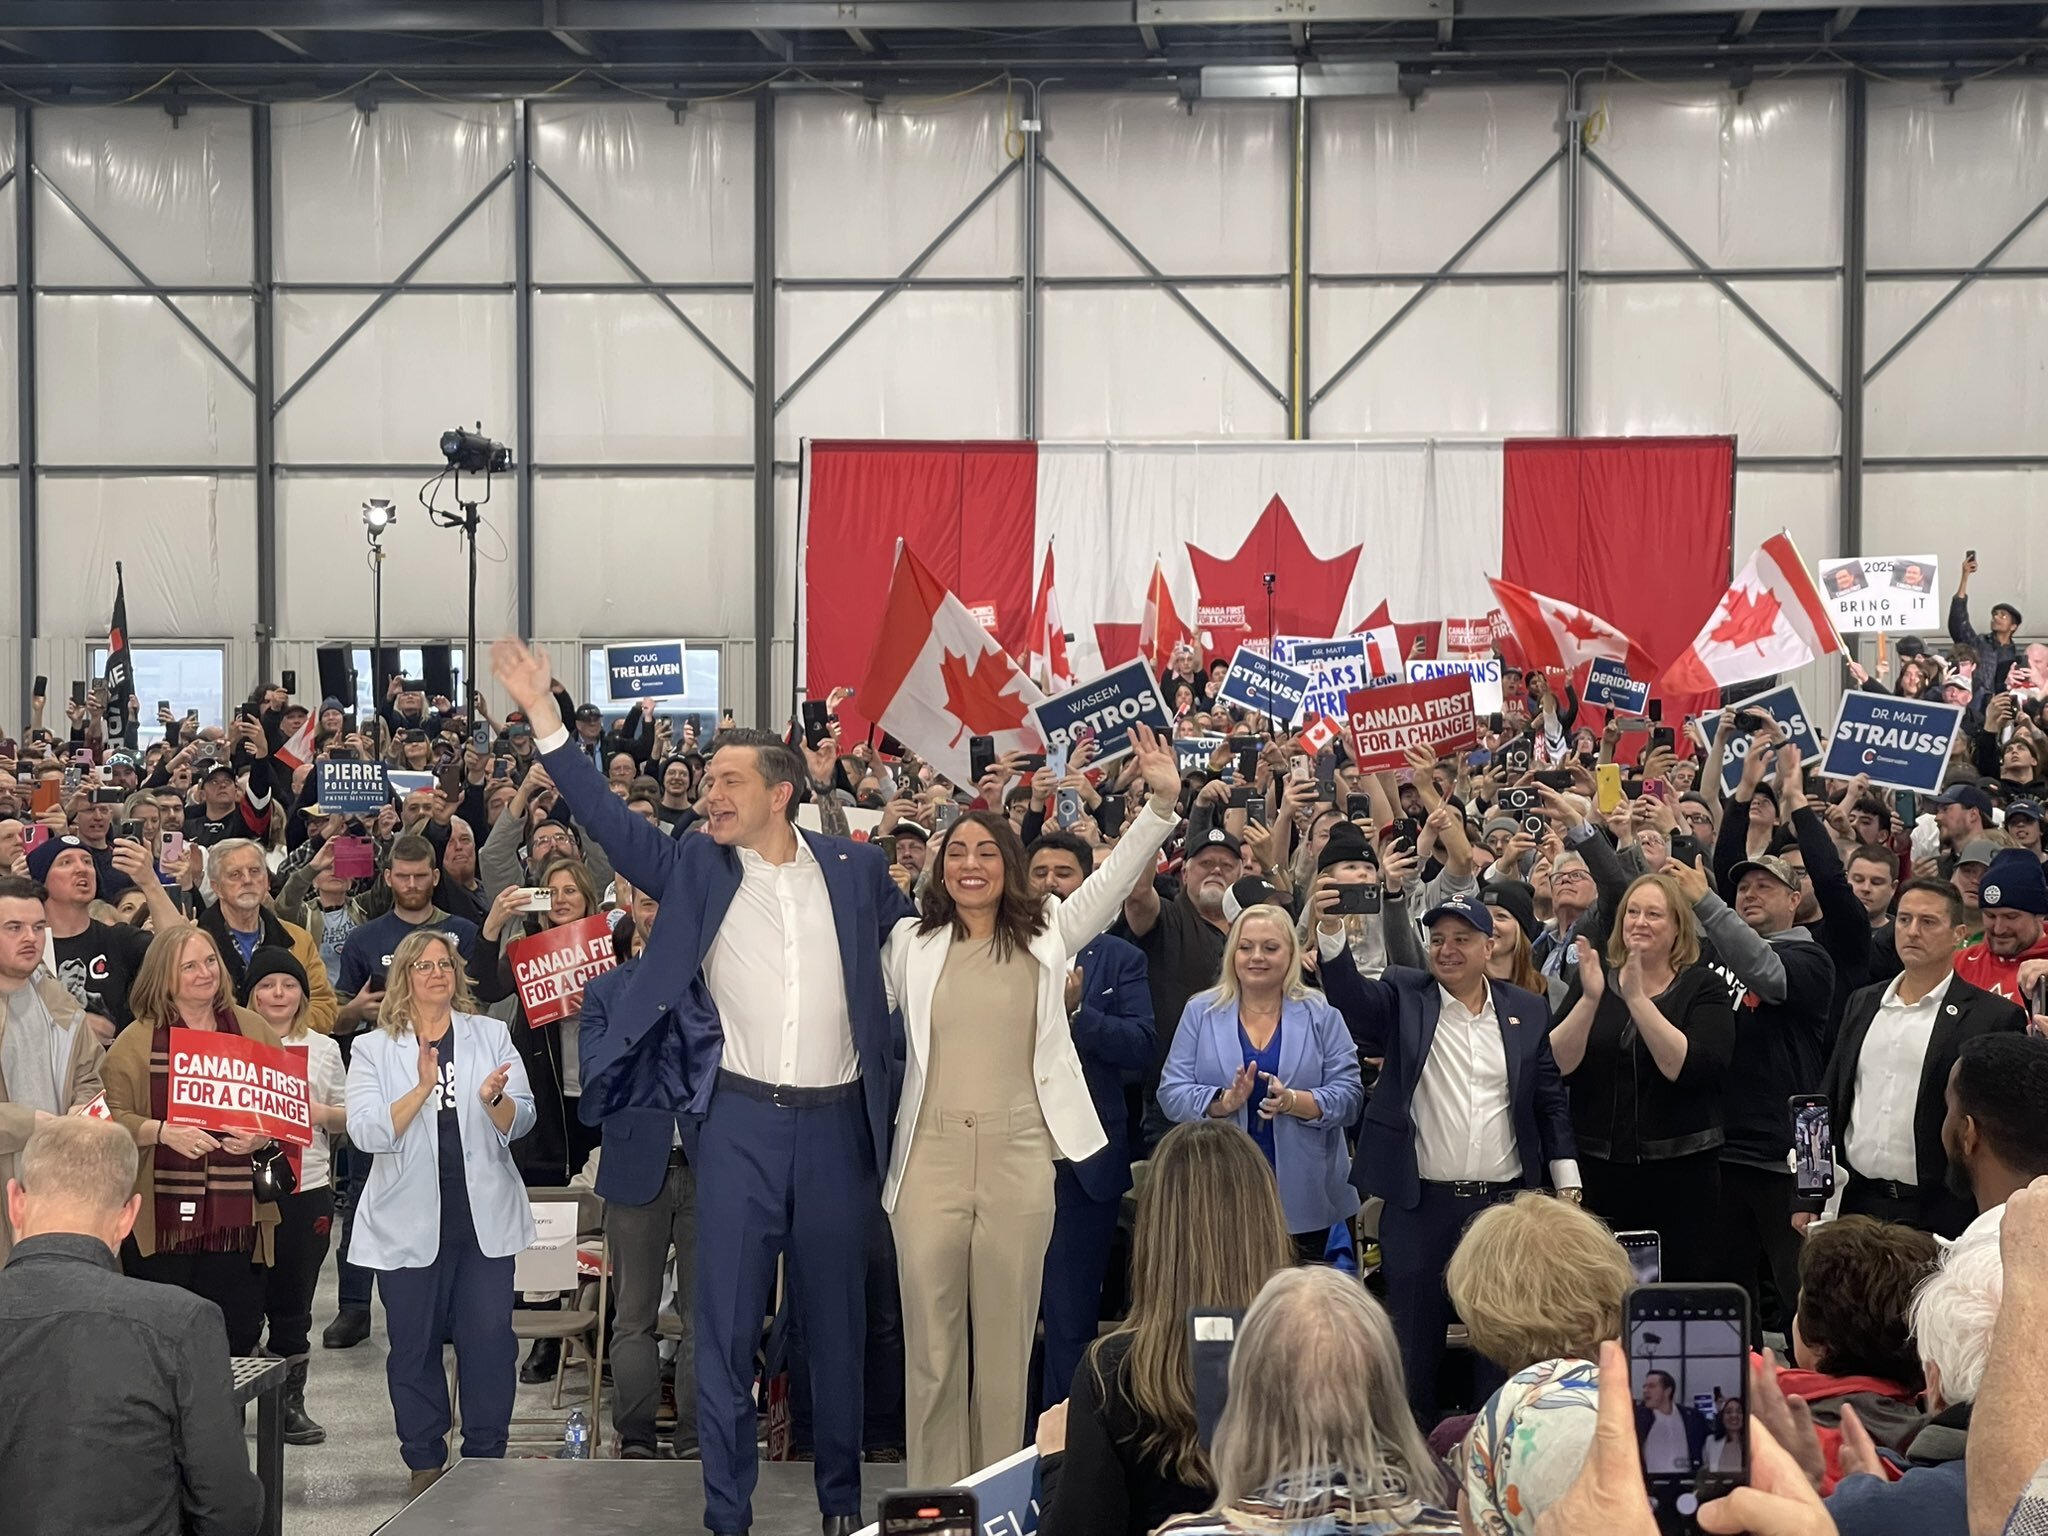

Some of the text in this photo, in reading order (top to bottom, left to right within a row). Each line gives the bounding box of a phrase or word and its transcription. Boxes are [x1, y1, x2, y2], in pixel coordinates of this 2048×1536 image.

[1864, 561, 1895, 573] 2025
[1199, 605, 1245, 615] CANADA FIRST
[1840, 598, 1926, 612] BRING IT
[1854, 614, 1907, 627] HOME
[633, 653, 658, 663] DOUG
[1326, 646, 1346, 655] MATT
[612, 663, 680, 678] TRELEAVEN
[1231, 665, 1302, 703] STRAUSS
[1591, 671, 1646, 694] DERIDDER
[1067, 684, 1121, 714] WASEEM
[1352, 692, 1471, 732] CANADA FIRST
[1871, 707, 1928, 726] DR. MATT
[1358, 714, 1472, 753] FOR A CHANGE
[1837, 720, 1948, 756] STRAUSS
[324, 763, 383, 780] PIERRE
[324, 781, 384, 791] POILIEVRE
[350, 794, 384, 802] MINISTER
[516, 943, 589, 982] CANADA
[525, 979, 558, 1005] FOR
[561, 974, 573, 994] A
[173, 1052, 307, 1100] CANADA FIRST
[176, 1080, 307, 1124] FOR A CHANGE
